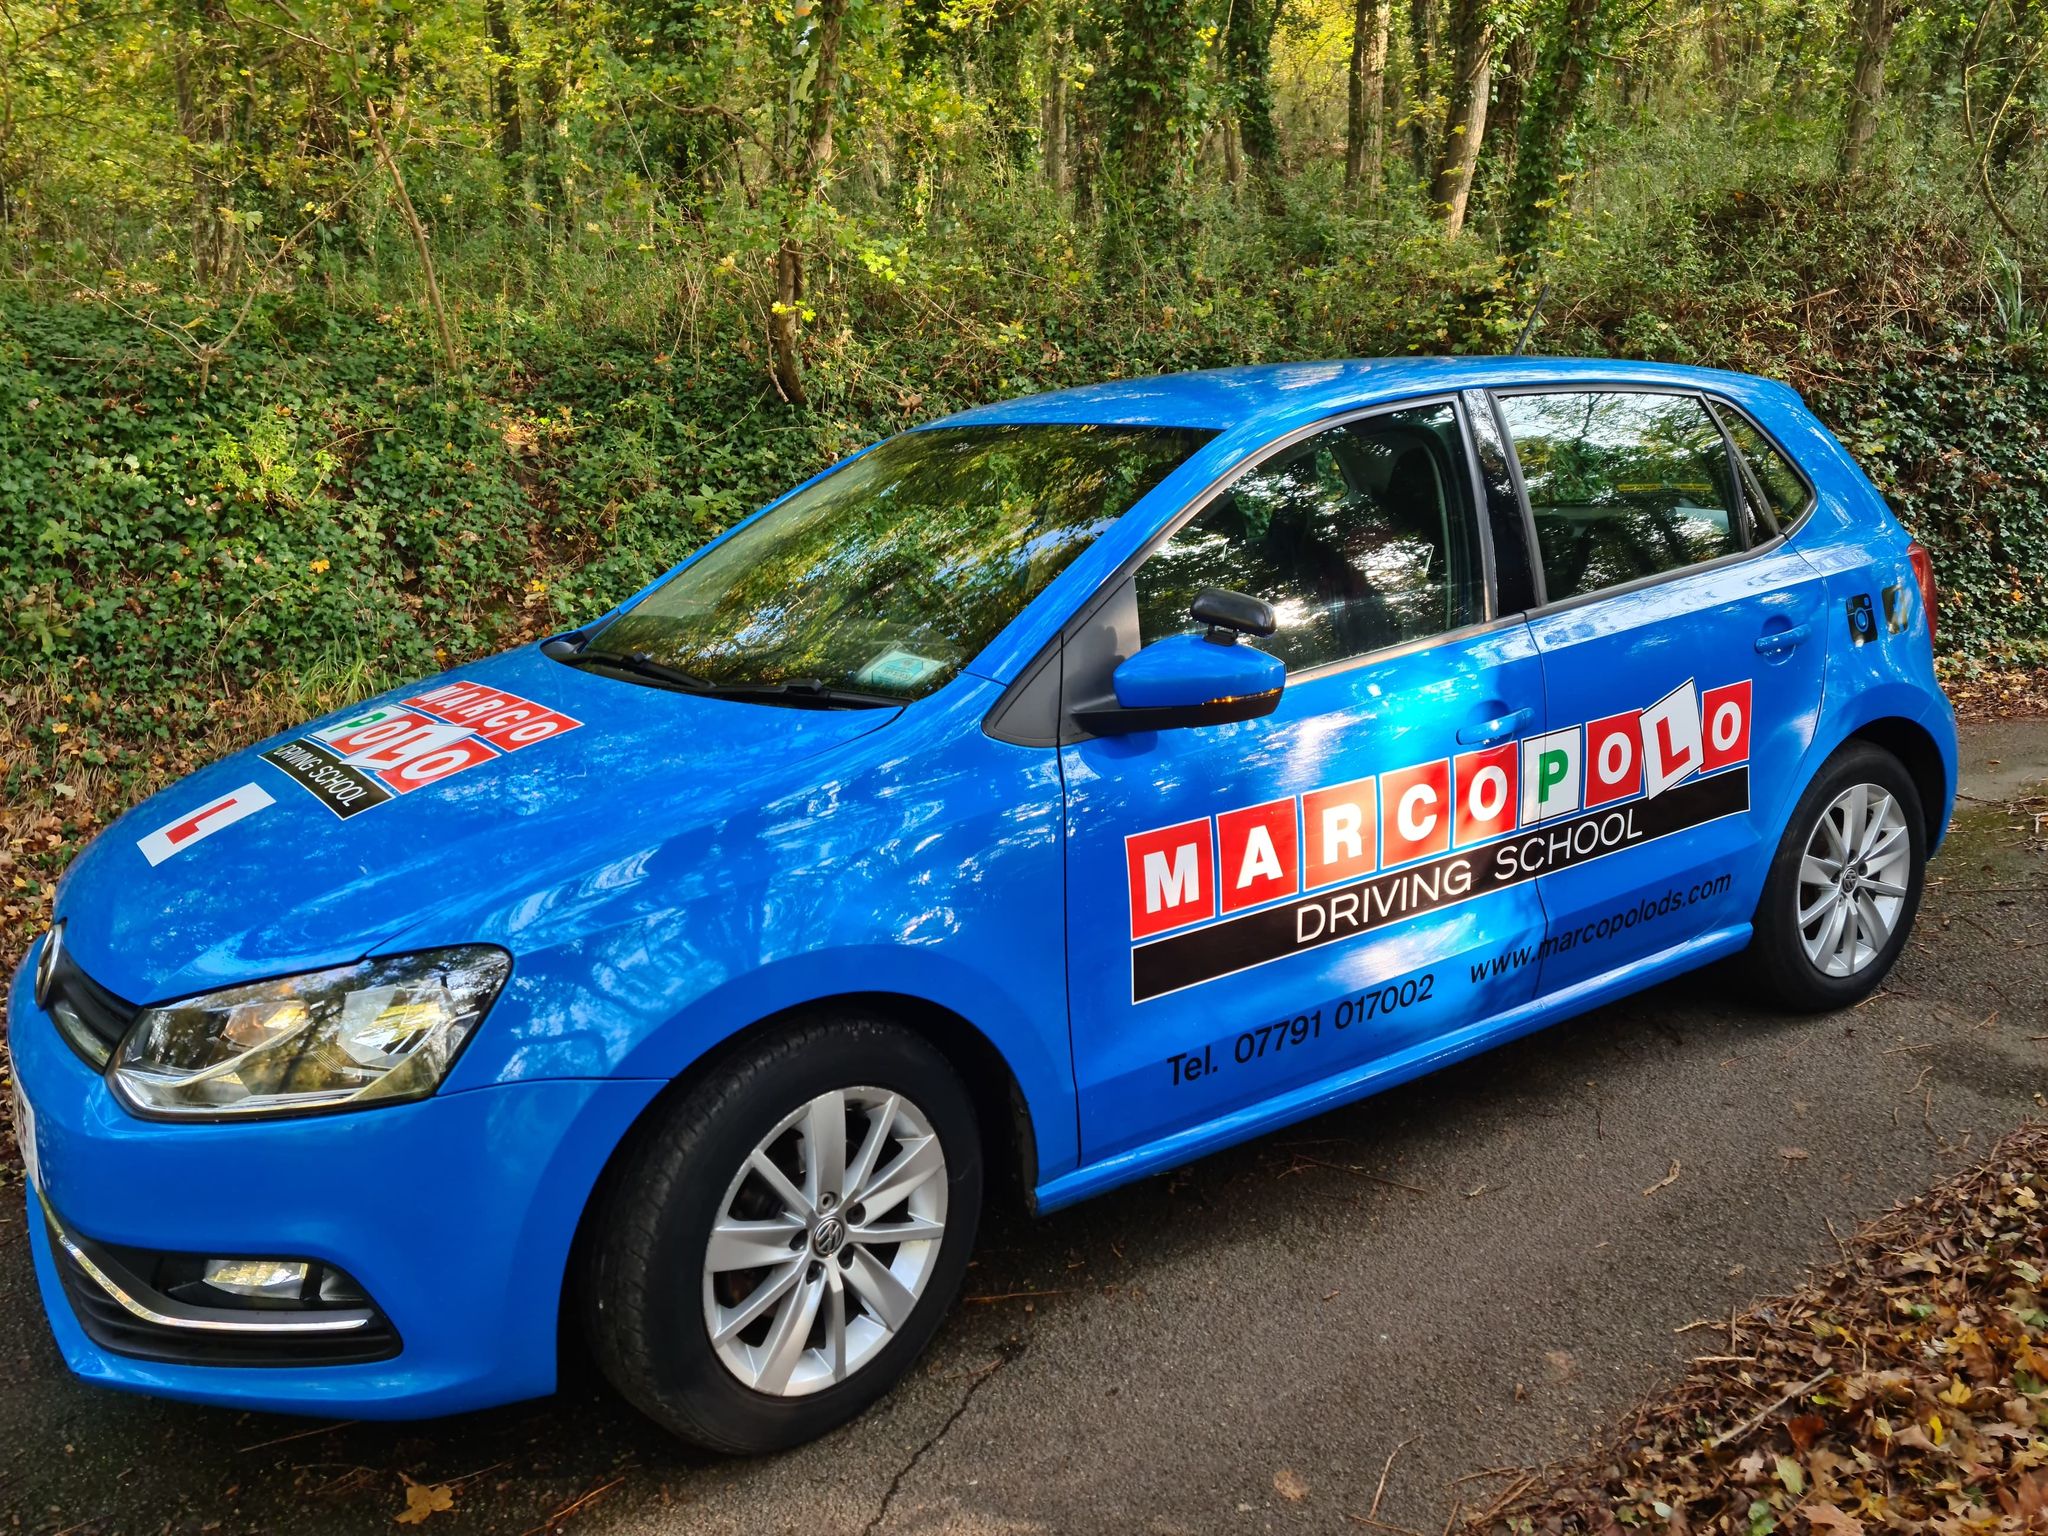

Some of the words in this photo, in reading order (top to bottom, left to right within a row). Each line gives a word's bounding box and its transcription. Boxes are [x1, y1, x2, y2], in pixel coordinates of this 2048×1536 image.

[327, 711, 471, 780] POLO
[415, 685, 559, 741] MARCO
[272, 744, 315, 770] DRIVING
[308, 762, 368, 807] SCHOOL
[165, 798, 238, 845] L
[1297, 860, 1472, 943] DRIVING
[1494, 808, 1643, 880] SCHOOL
[1470, 872, 1732, 984] www.marcopolods.com
[1167, 1045, 1219, 1086] Tel.
[1234, 1010, 1321, 1063] 07791
[1334, 973, 1435, 1030] 017002
